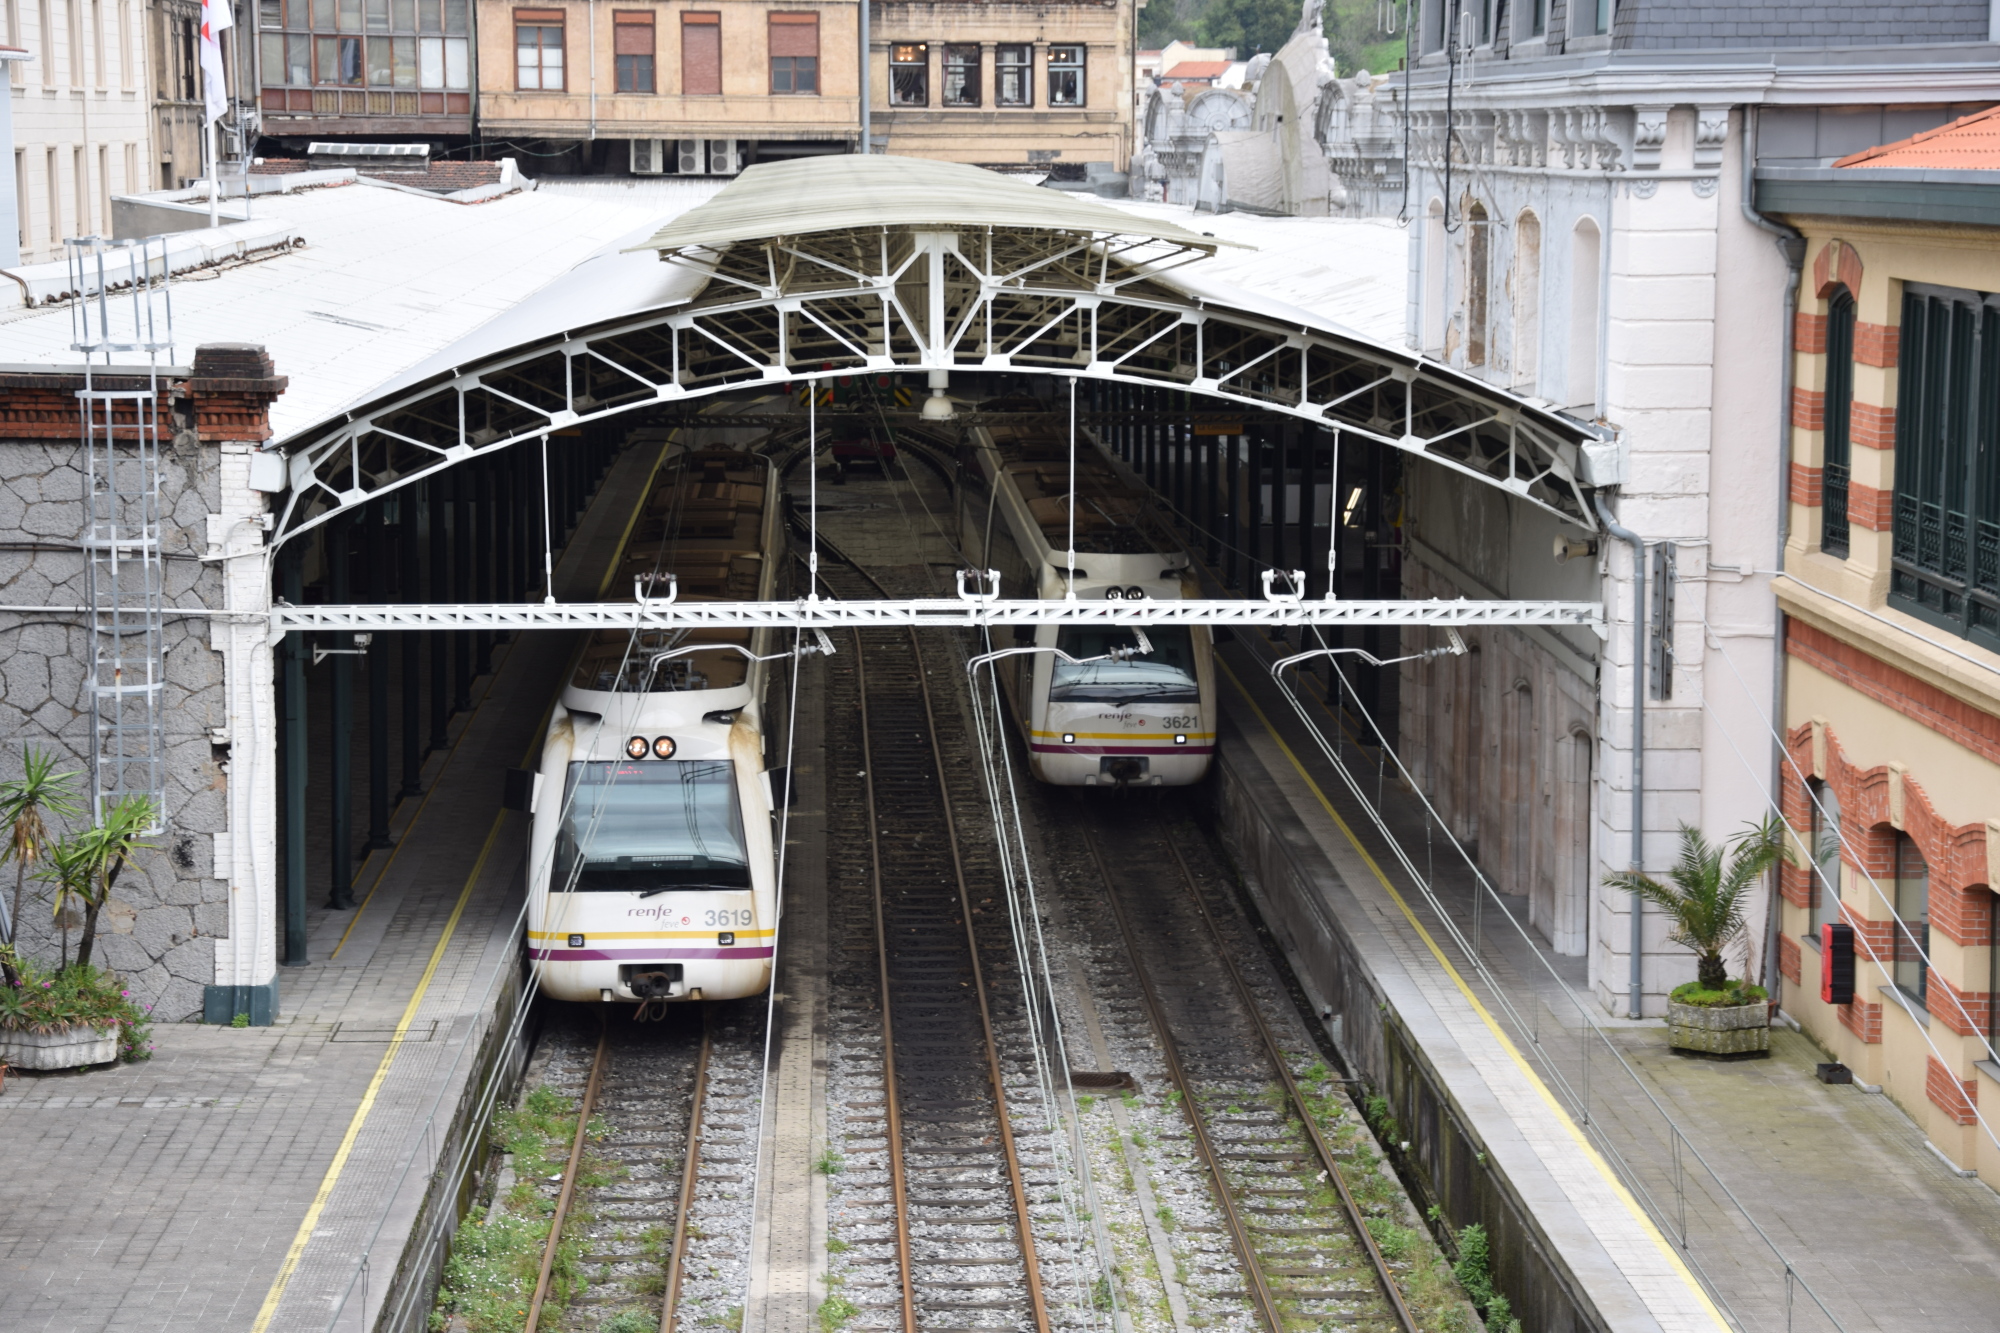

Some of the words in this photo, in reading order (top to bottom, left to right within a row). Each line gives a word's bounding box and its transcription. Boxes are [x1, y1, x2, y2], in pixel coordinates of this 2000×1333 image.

[1098, 710, 1132, 722] renfe
[1162, 716, 1198, 729] 3621
[627, 904, 672, 921] renfe
[704, 909, 753, 927] 3619
[660, 919, 680, 930] feve
